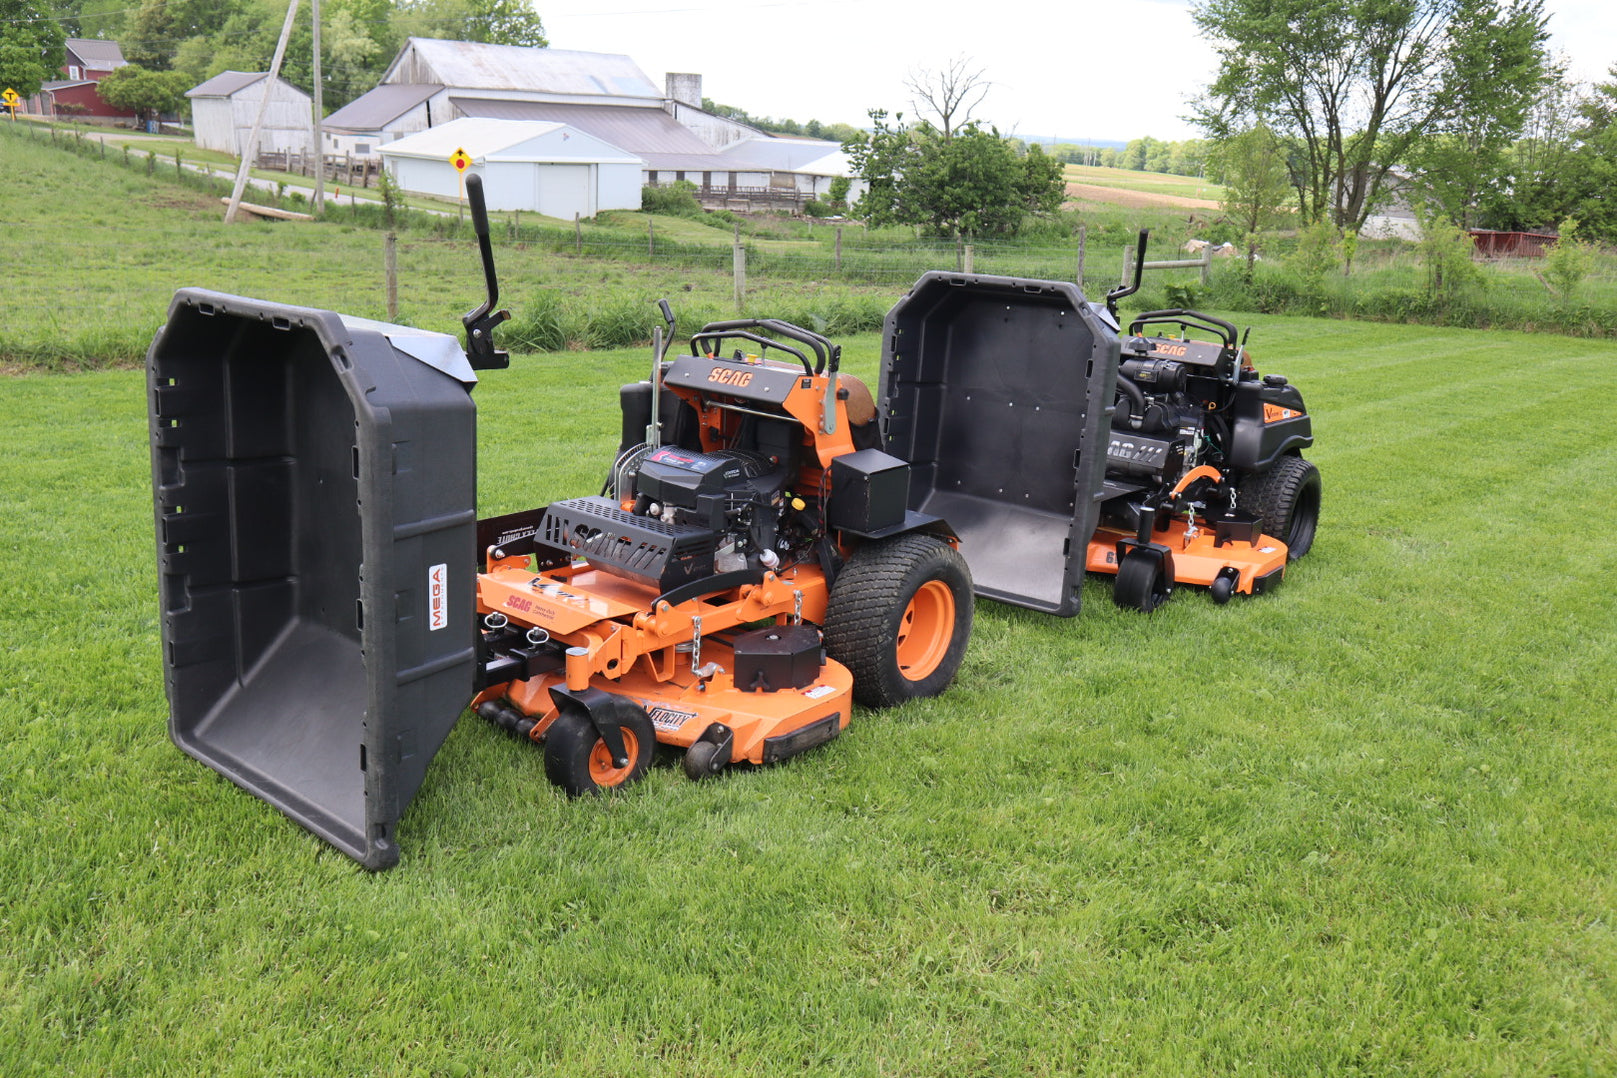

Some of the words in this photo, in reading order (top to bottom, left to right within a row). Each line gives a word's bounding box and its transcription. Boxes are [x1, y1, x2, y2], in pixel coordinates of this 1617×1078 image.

[708, 366, 754, 388] SCAG
[569, 523, 632, 563] SCAG
[432, 568, 441, 627] MEGA
[507, 594, 532, 613] SCAG
